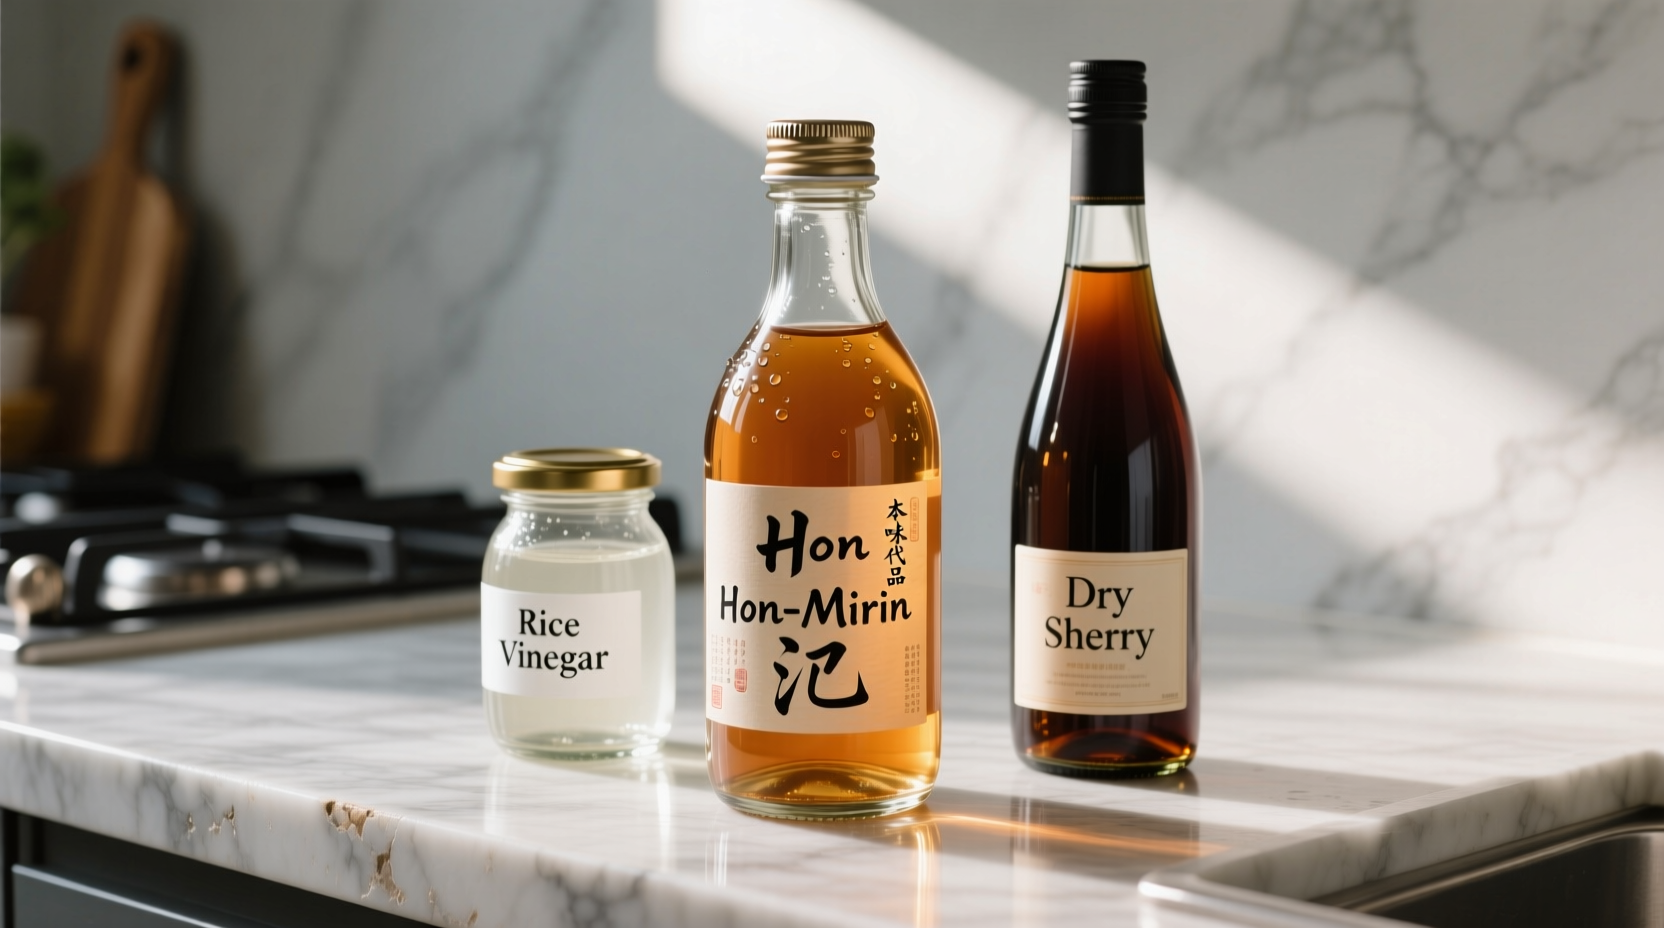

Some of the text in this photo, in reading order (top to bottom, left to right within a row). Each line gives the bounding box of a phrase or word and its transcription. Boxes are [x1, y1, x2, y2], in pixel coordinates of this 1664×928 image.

[756, 509, 870, 578] Hon
[884, 498, 908, 586] 本味代品
[720, 585, 912, 628] Hon-Mirin
[1066, 576, 1134, 618] Dry
[519, 608, 580, 637] Rice
[1045, 616, 1155, 660] Sherry
[500, 639, 609, 679] Vinegar
